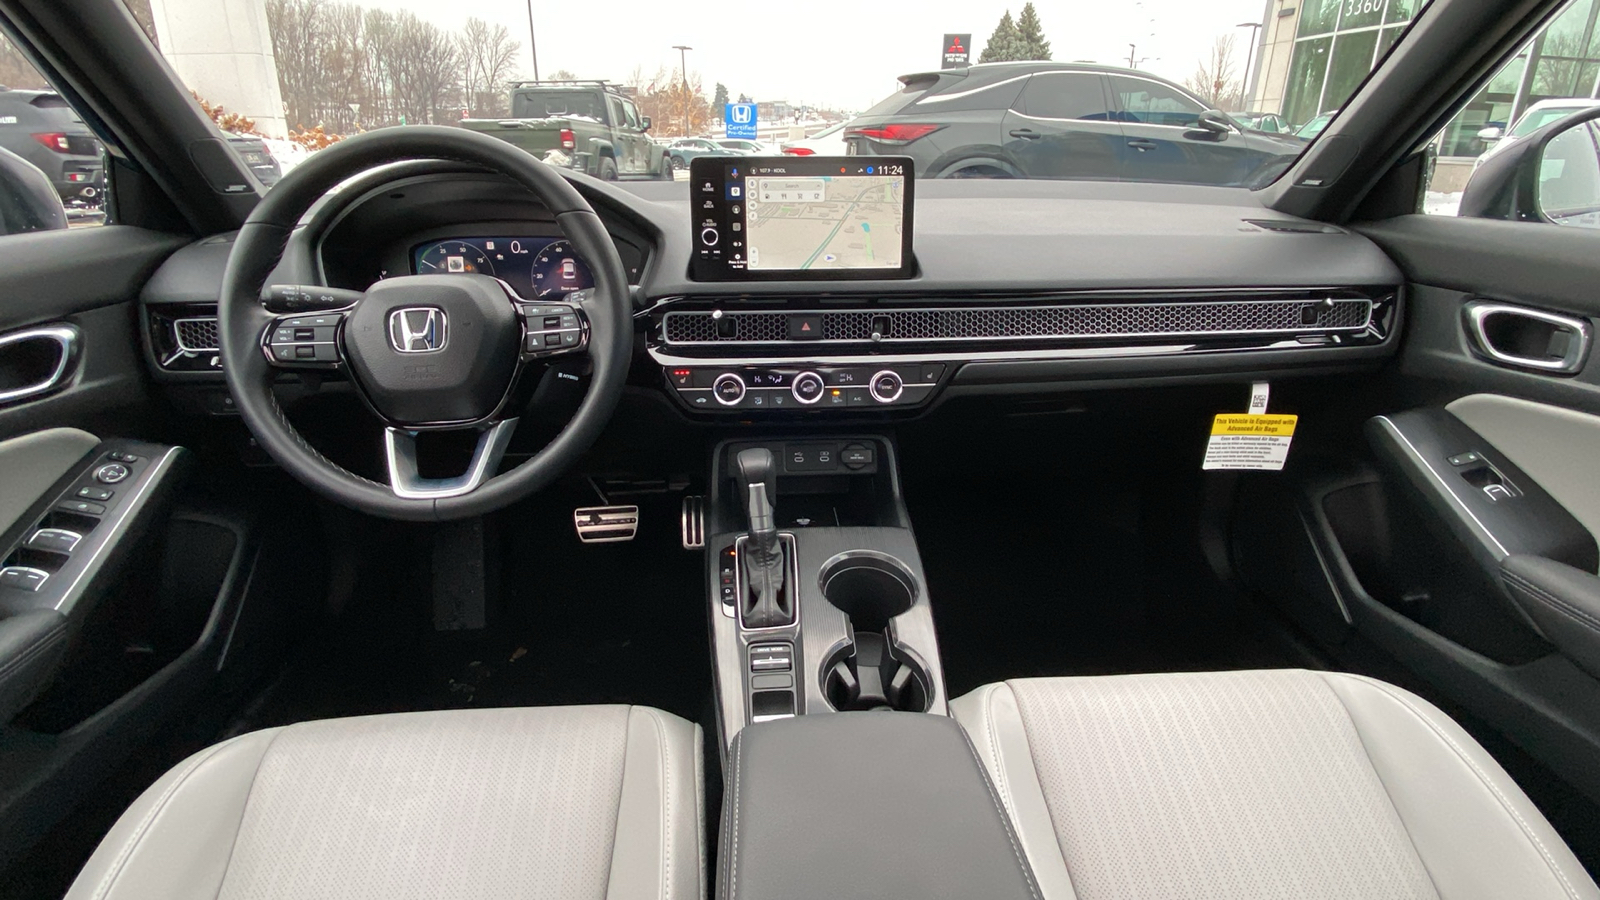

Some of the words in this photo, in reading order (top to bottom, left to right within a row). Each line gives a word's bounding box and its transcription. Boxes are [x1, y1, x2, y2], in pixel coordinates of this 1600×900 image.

[1345, 0, 1382, 16] 3360
[878, 165, 903, 175] 11:24
[511, 240, 520, 254] 0
[1255, 418, 1281, 426] Equipped
